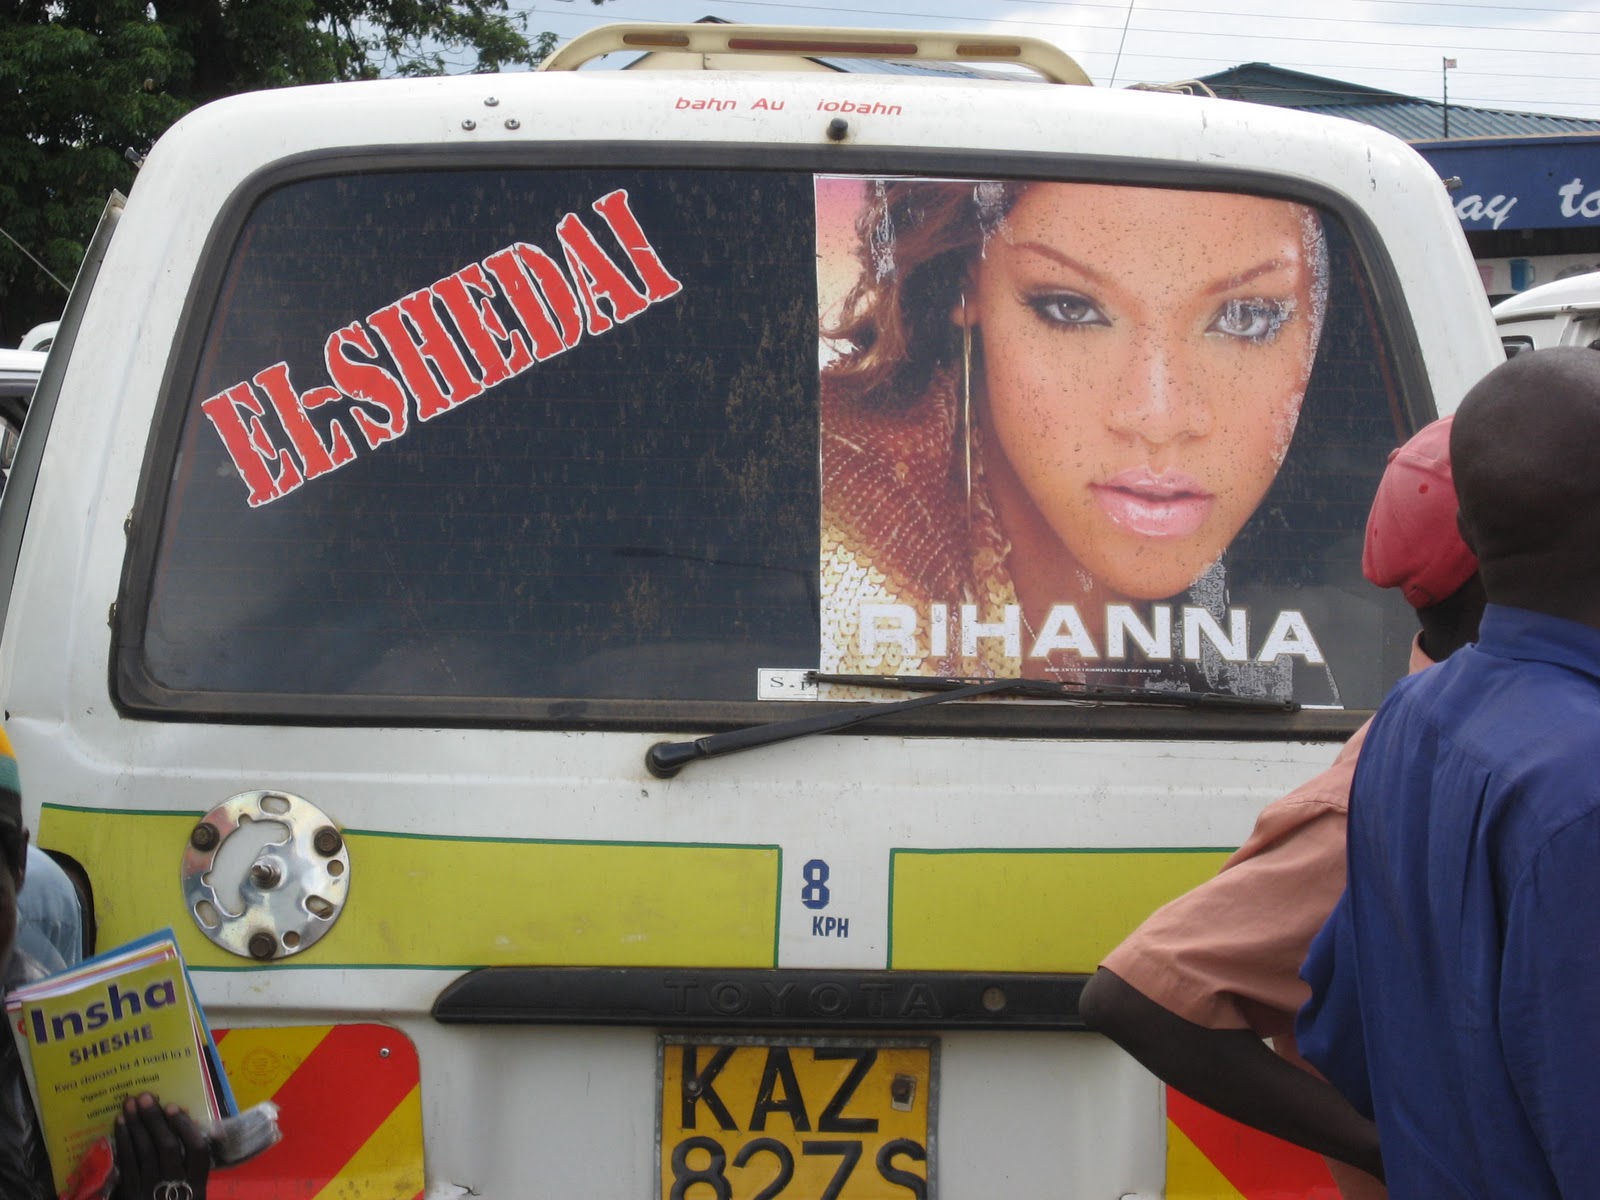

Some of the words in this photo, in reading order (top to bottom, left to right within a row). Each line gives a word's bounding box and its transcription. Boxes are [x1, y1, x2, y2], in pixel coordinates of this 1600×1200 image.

[674, 97, 737, 111] bahn
[816, 99, 902, 116] iobahn
[1450, 194, 1518, 230] ay
[201, 188, 683, 507] EL-SHEDAI
[858, 604, 1325, 664] RIHANNA
[812, 916, 849, 938] KPH
[31, 979, 177, 1045] Insha
[664, 979, 944, 1018] TOYOTA
[69, 1024, 154, 1066] SHESHE
[681, 1045, 879, 1133] KAZ
[670, 1136, 927, 1200] 827S
